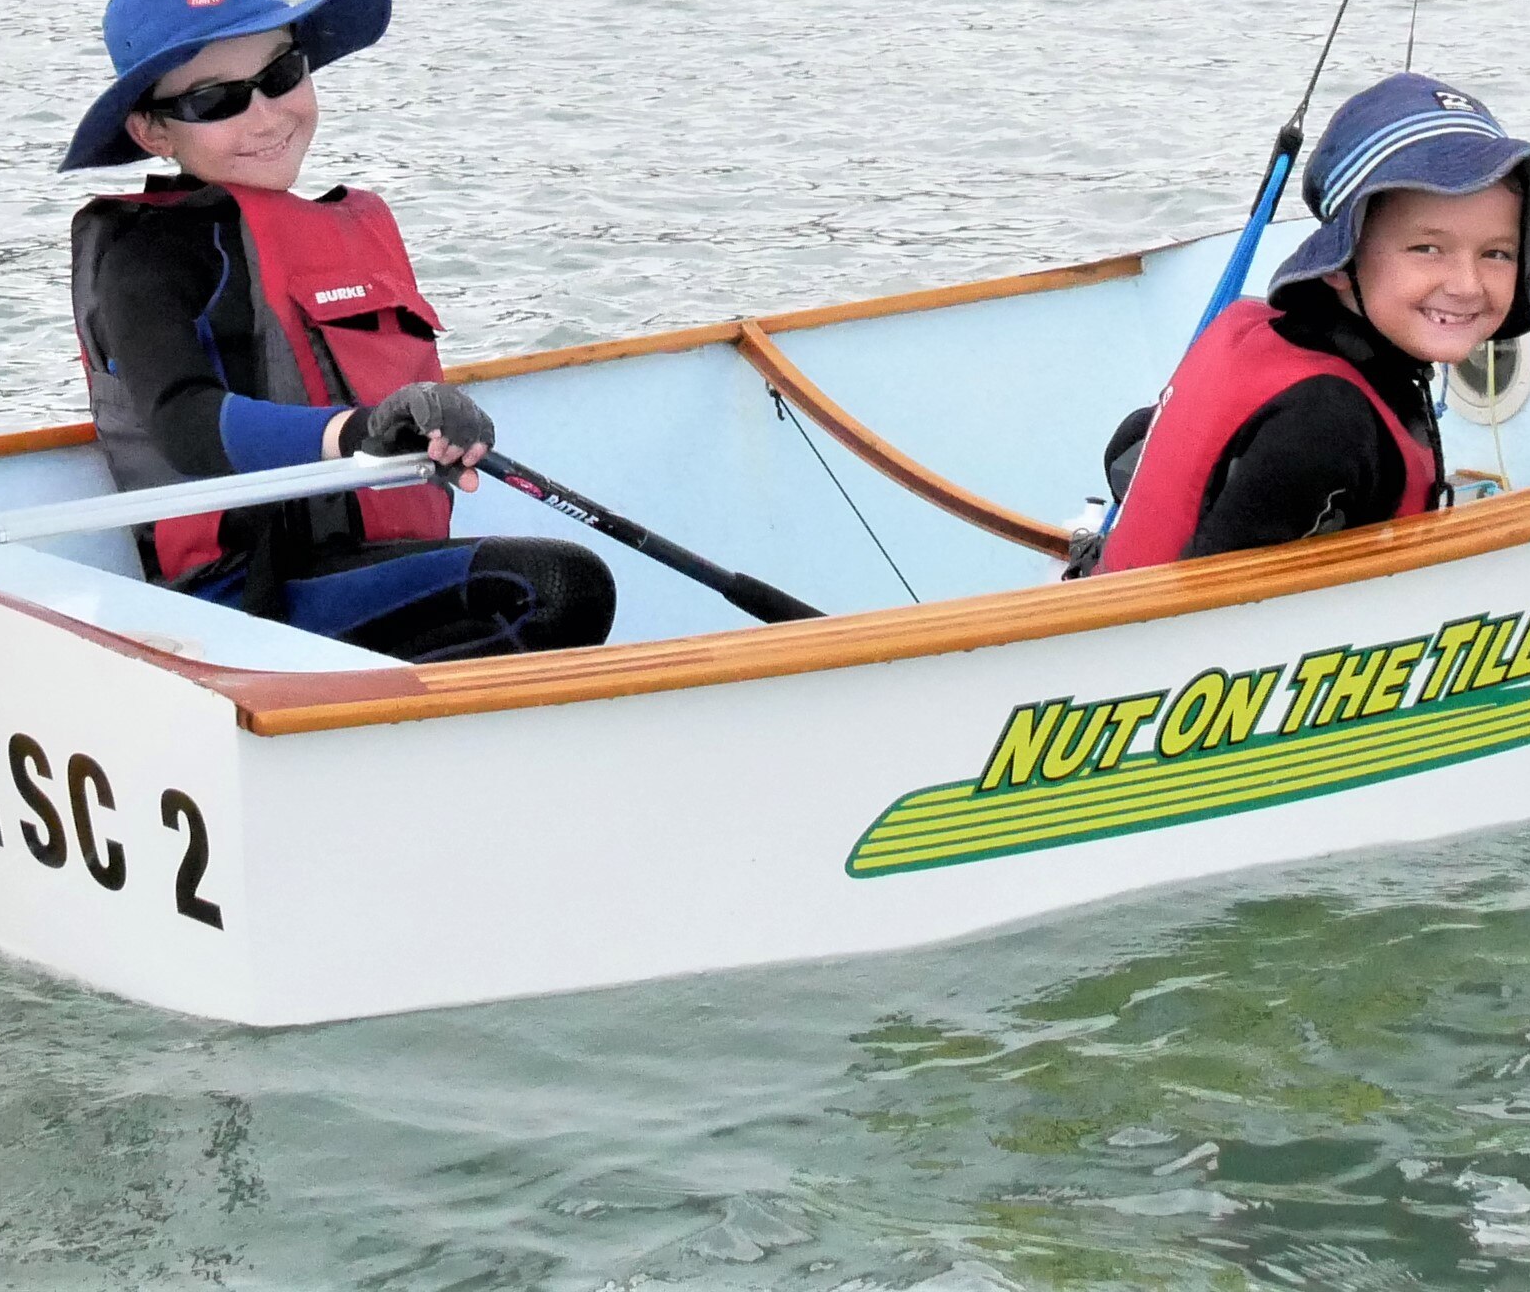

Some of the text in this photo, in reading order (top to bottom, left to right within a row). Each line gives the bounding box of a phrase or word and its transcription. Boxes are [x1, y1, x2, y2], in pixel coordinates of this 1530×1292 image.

[315, 285, 366, 304] BURKE
[978, 692, 1168, 792] NUT
[1158, 668, 1284, 758] ON
[1280, 635, 1432, 736] THE
[160, 788, 224, 931] 2
